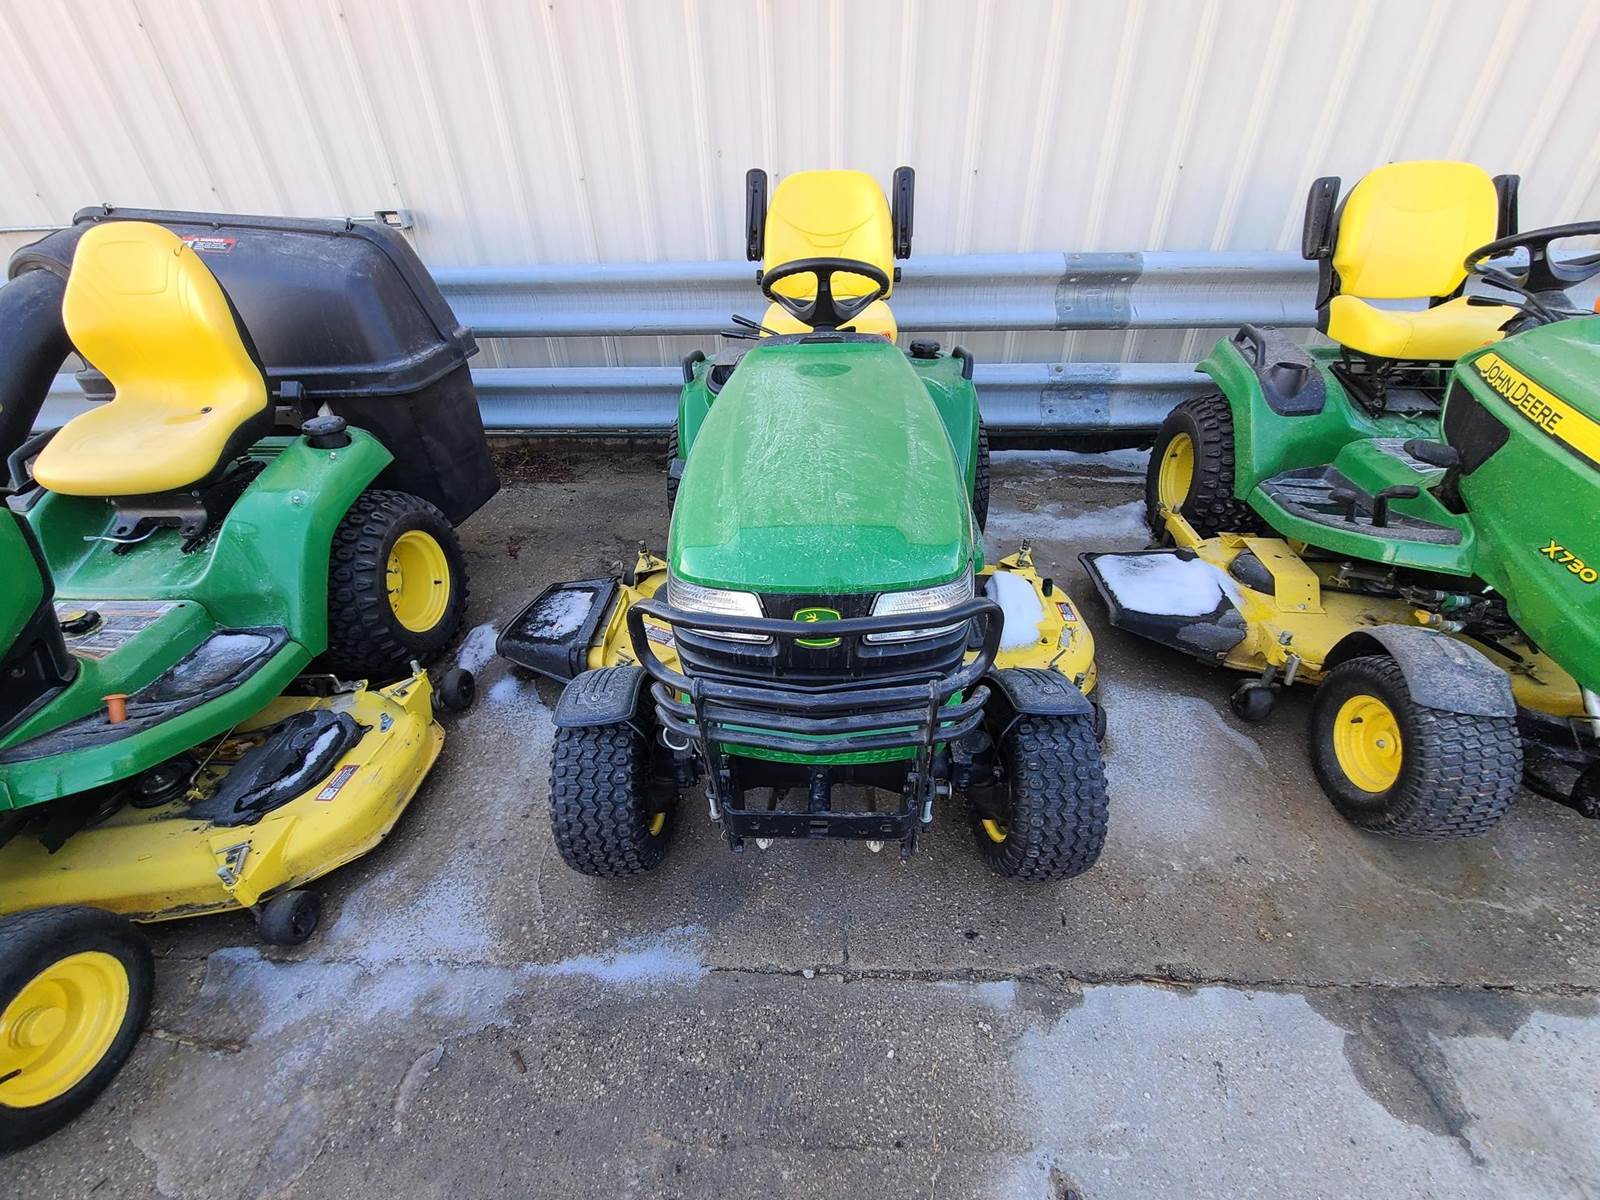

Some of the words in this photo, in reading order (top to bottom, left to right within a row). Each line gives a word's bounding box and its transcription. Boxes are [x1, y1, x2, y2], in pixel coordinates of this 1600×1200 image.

[1482, 359, 1517, 394] JOHN
[1510, 382, 1564, 431] DEERE
[1539, 538, 1599, 584] X730
